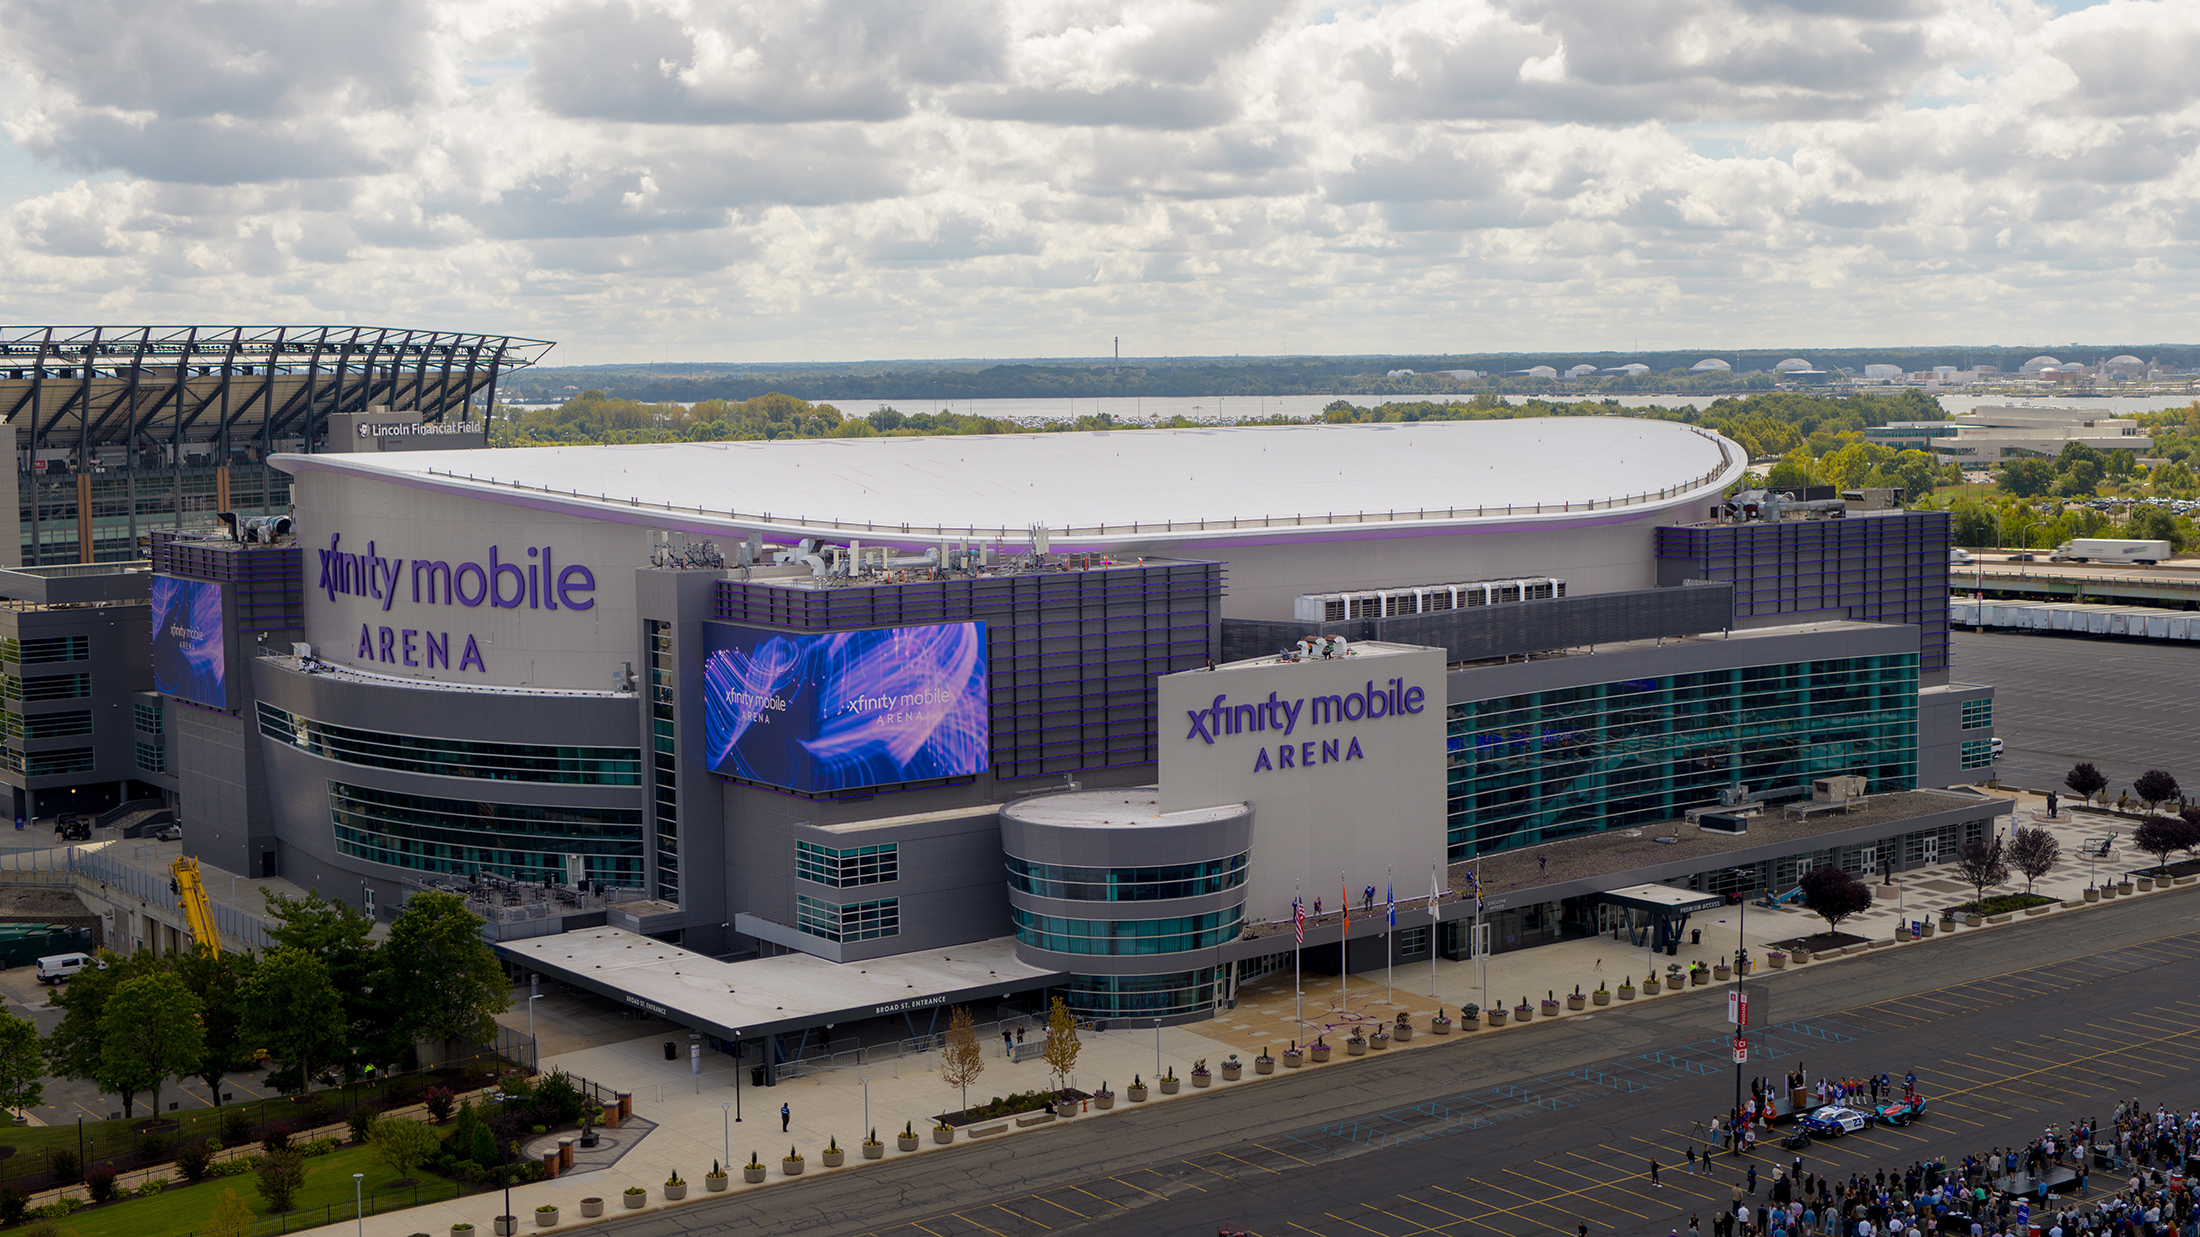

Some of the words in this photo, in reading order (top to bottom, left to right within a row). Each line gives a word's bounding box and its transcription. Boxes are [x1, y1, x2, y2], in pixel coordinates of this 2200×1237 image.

[372, 423, 410, 437] Lincoln
[411, 421, 456, 436] Financial
[457, 420, 480, 434] Field
[318, 532, 402, 611] xfinity
[411, 545, 595, 611] mobile
[357, 623, 486, 672] ARENA
[725, 687, 754, 706] xfinity
[755, 694, 786, 712] mobile
[849, 694, 898, 714] xfinity
[900, 687, 950, 707] mobile
[1187, 691, 1304, 744] xfinity
[1312, 677, 1425, 725] mobile
[741, 711, 771, 725] ARENA
[876, 711, 924, 725] ARENA
[1254, 736, 1365, 773] ARENA
[1701, 901, 1720, 910] ACCESS
[875, 1003, 899, 1014] BROAD
[900, 1001, 911, 1010] ST.
[911, 995, 946, 1008] ENTRANCE
[1852, 1117, 1862, 1127] 23
